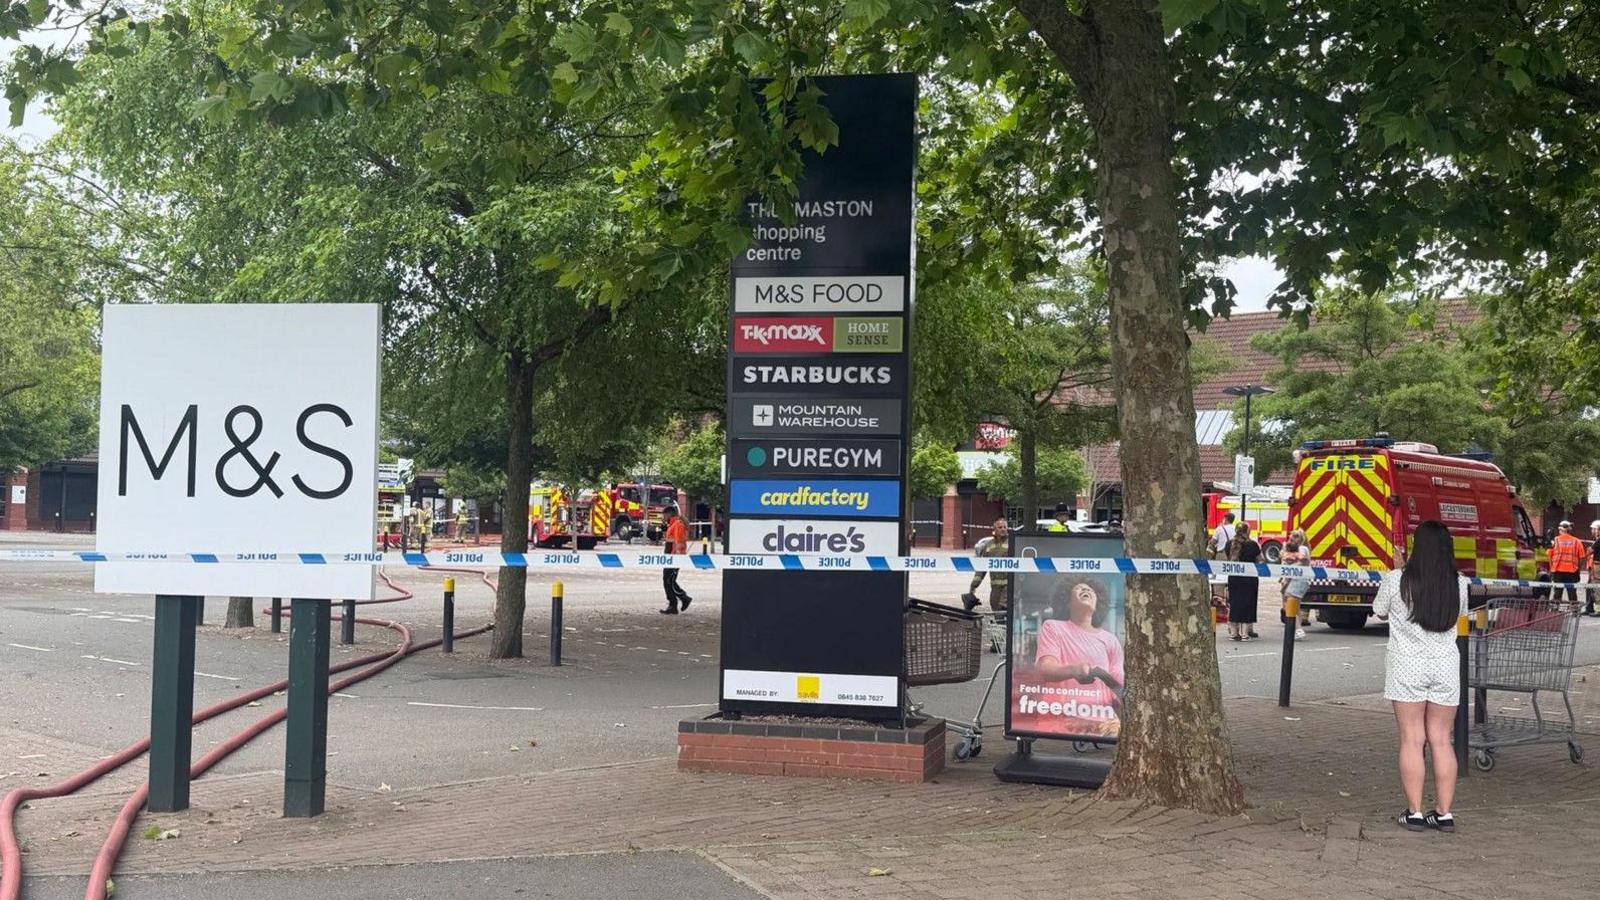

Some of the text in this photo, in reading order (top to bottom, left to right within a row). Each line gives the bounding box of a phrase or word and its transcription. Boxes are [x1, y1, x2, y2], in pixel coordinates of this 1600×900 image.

[746, 246, 801, 261] centre
[755, 283, 883, 304] M&S FOOD
[848, 322, 889, 334] HOME
[847, 335, 889, 346] SENSE
[743, 366, 891, 384] STARBUCKS
[779, 405, 862, 415] MOUNTAIN
[778, 417, 879, 427] WAREHOUSE
[118, 403, 354, 500] M&S
[773, 447, 882, 468] PUREGYM
[1312, 460, 1374, 470] FIRE
[760, 487, 869, 510] cardfactory
[763, 525, 865, 553] claire's
[446, 553, 483, 563] POLICE
[544, 554, 580, 564] POLICE
[638, 555, 673, 565] POLICE
[730, 556, 764, 566] POLICE
[818, 557, 851, 567] POLICE
[904, 558, 936, 568] POLICE
[988, 559, 1019, 569] POLICE
[1070, 560, 1100, 570] POLICE
[1150, 560, 1180, 570] POLICE
[1222, 563, 1245, 574] POLICE
[1281, 566, 1303, 577] POLICE
[736, 689, 768, 697] MANAGED
[1020, 684, 1102, 697] Feel no contract
[1019, 695, 1115, 719] freedom
